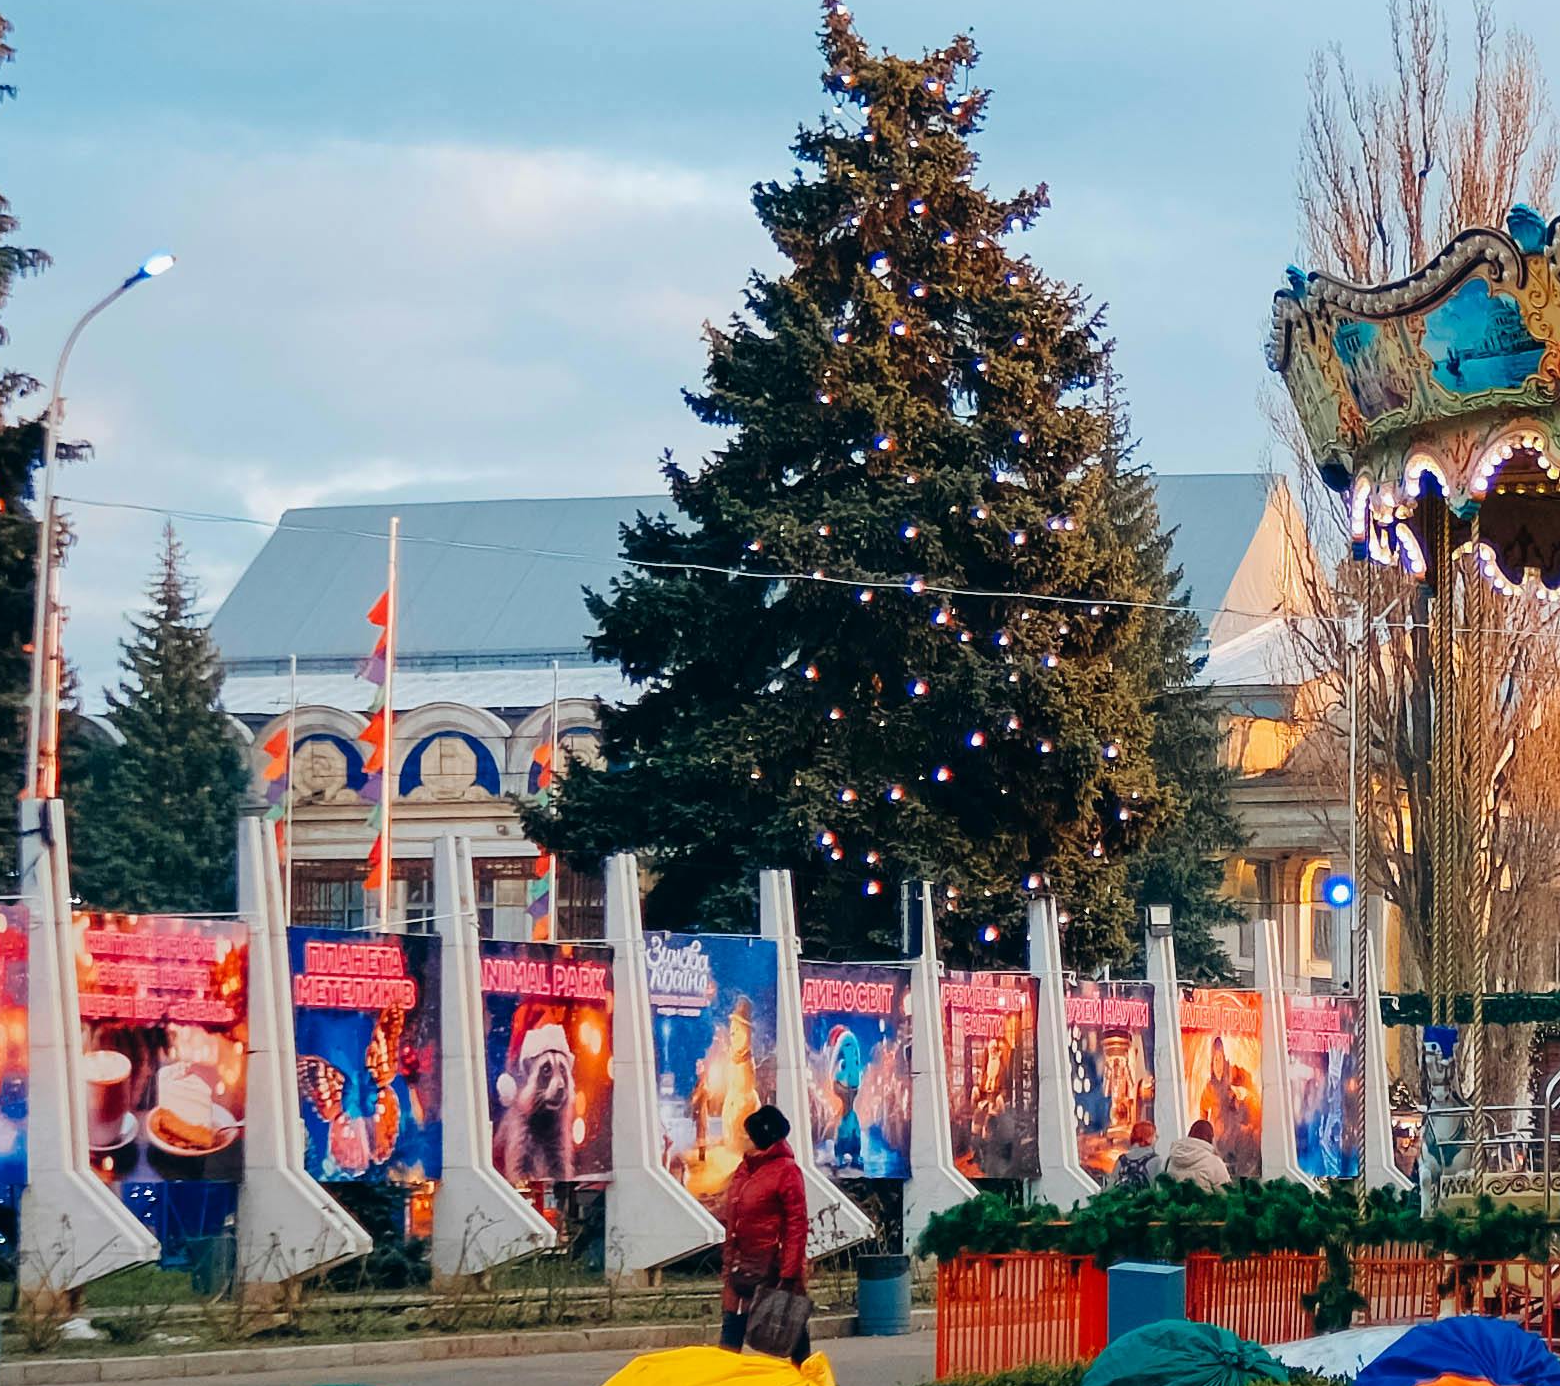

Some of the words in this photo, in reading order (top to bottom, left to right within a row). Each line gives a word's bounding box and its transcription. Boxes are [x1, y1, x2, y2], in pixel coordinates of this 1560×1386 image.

[306, 942, 404, 977] ПЛАНЕТА
[295, 975, 416, 1009] МЕТЕЛИКІВ
[553, 964, 607, 999] PARK
[802, 978, 894, 1013] ДИНОСВІТ
[1103, 999, 1149, 1028] НАУКИ
